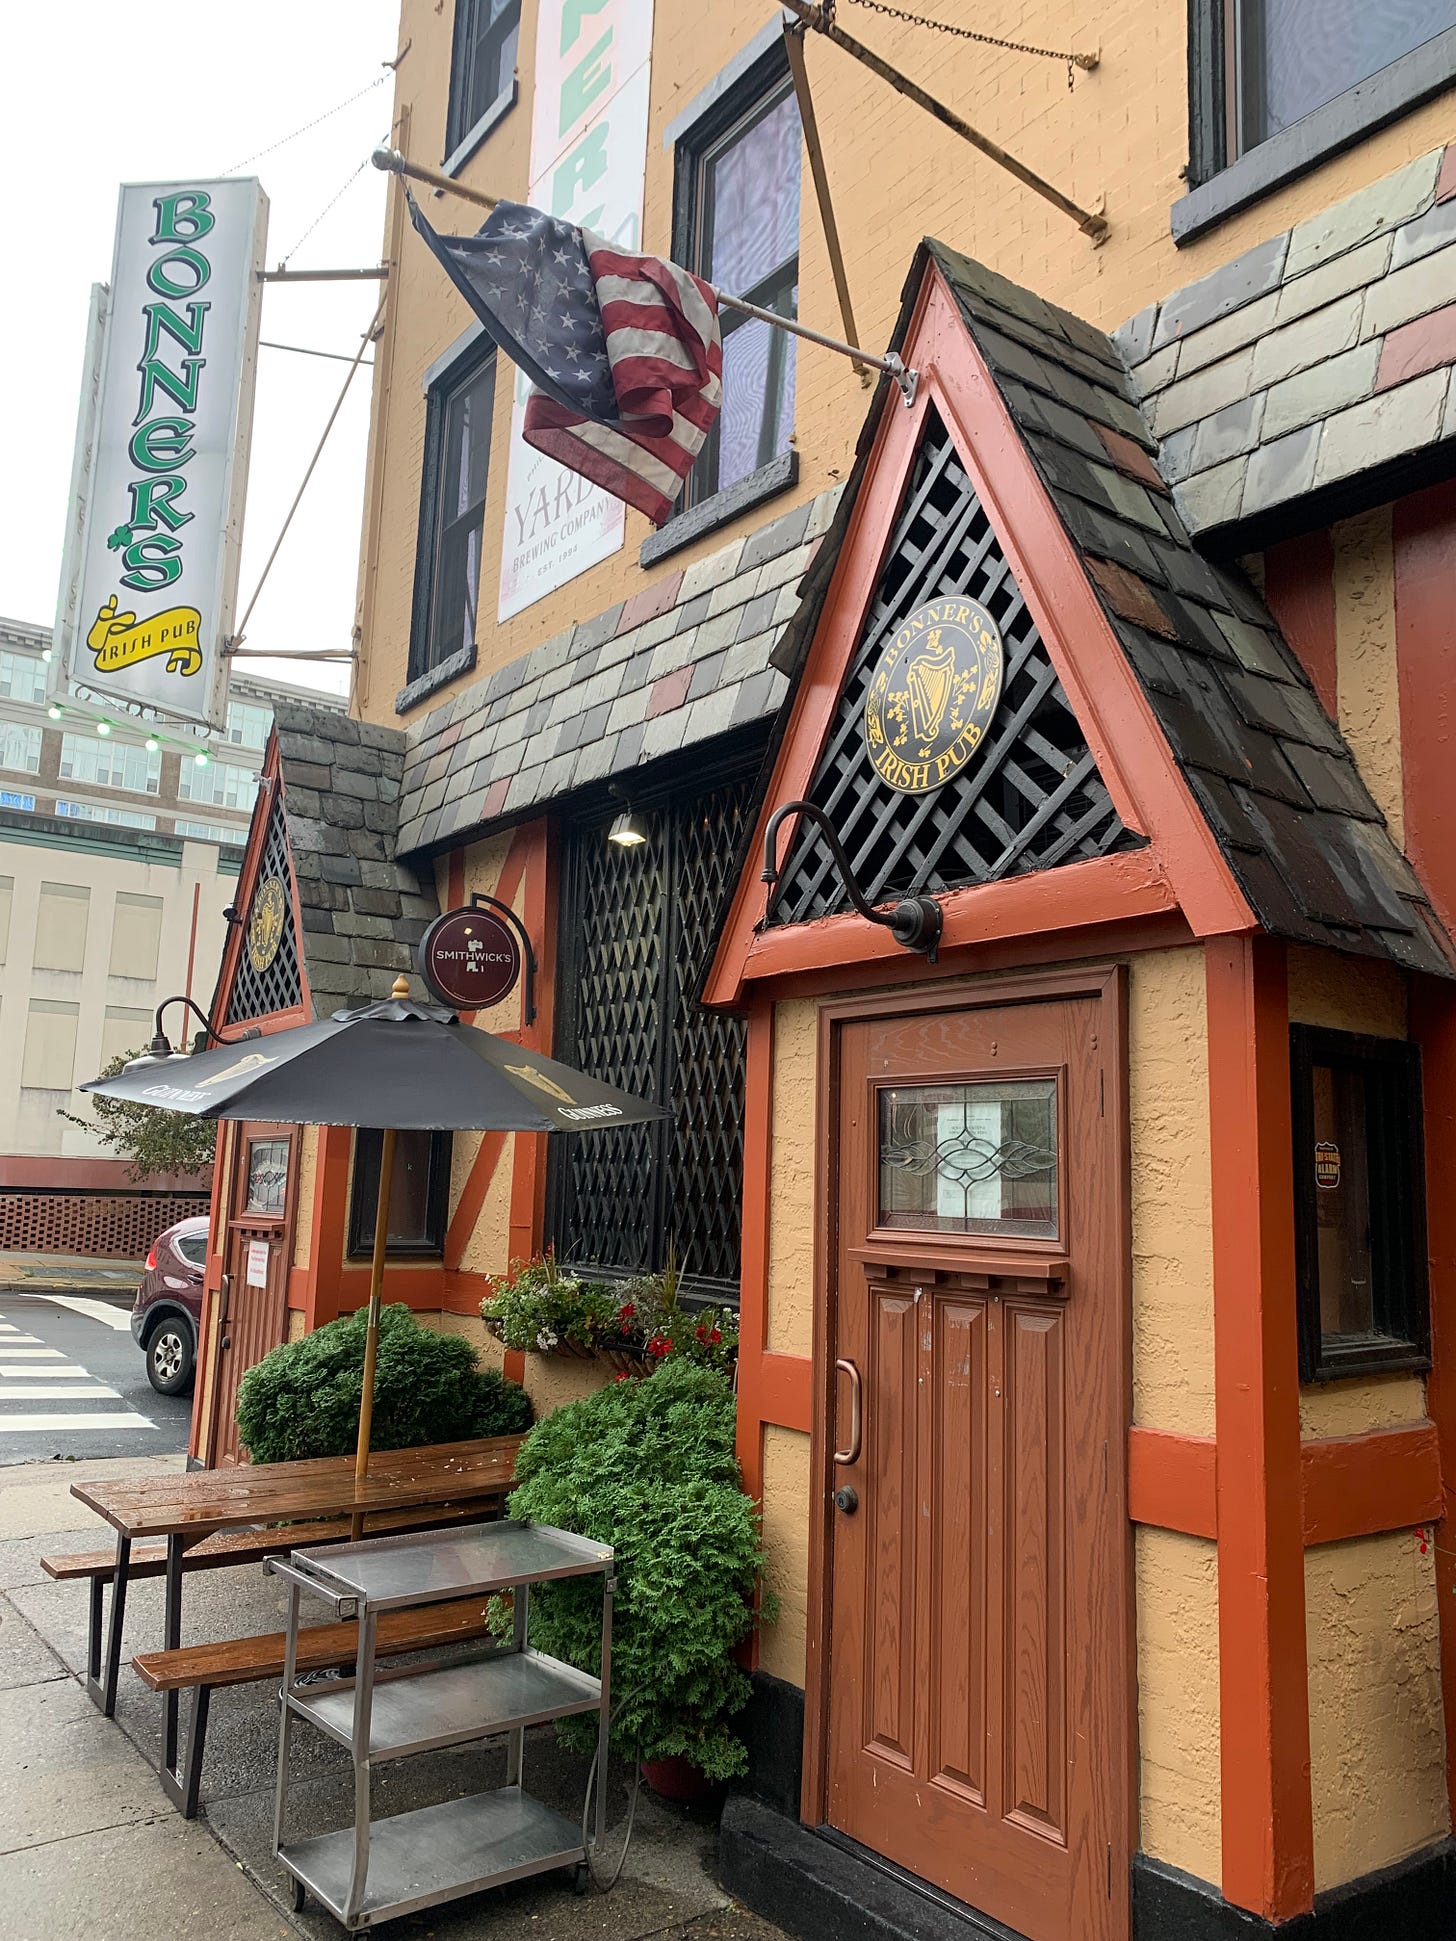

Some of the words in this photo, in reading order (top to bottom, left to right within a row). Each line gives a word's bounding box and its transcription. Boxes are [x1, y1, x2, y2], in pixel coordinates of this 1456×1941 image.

[512, 532, 558, 573] BREWING
[560, 497, 610, 541] COMPANY
[514, 469, 595, 548] YARD
[102, 633, 151, 662] IRISH
[160, 620, 196, 644] PUB
[884, 603, 984, 667] BONNER'S
[875, 746, 931, 789] IRISH
[937, 723, 981, 781] PUB
[436, 950, 512, 963] SMITHWICK'S
[557, 1103, 623, 1121] GUINNESS
[1317, 1163, 1338, 1174] ALARM
